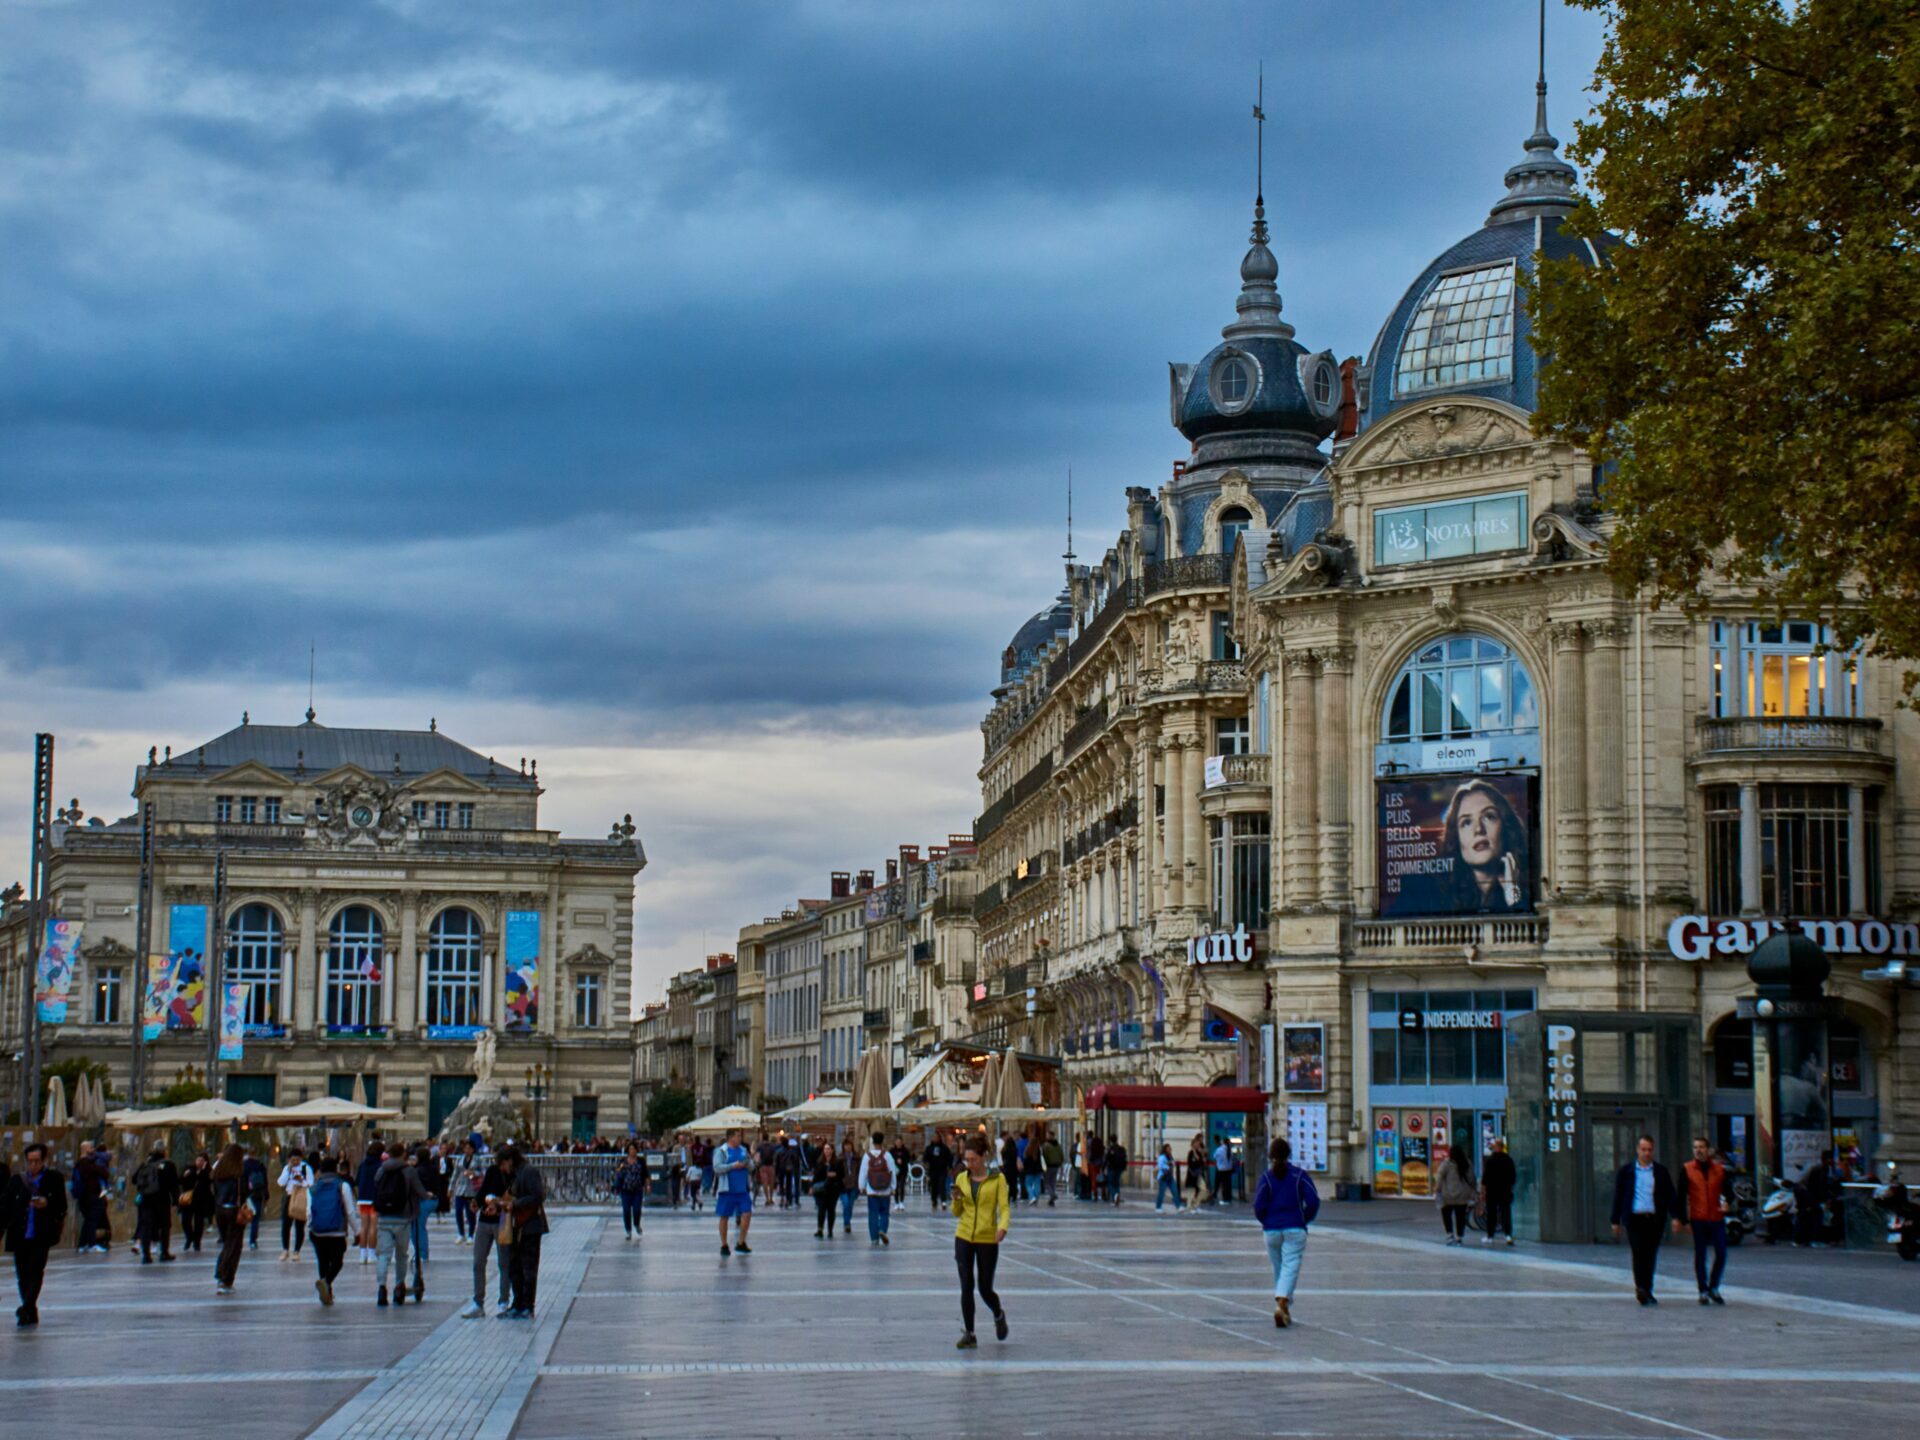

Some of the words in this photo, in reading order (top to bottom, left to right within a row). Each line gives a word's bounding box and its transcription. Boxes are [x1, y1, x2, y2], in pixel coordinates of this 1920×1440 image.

[1422, 518, 1509, 544] NOTAIRES
[1437, 746, 1476, 760] eleom
[1386, 793, 1403, 807] LES
[1386, 809, 1411, 824] PLUS
[1386, 826, 1421, 841] BELLES
[1387, 842, 1437, 858] HISTOIRES
[1387, 858, 1455, 875] COMMENCENT
[1387, 879, 1401, 893] ICI
[1423, 1011, 1494, 1028] INDEPENDENCE
[1547, 1024, 1576, 1152] Parking
